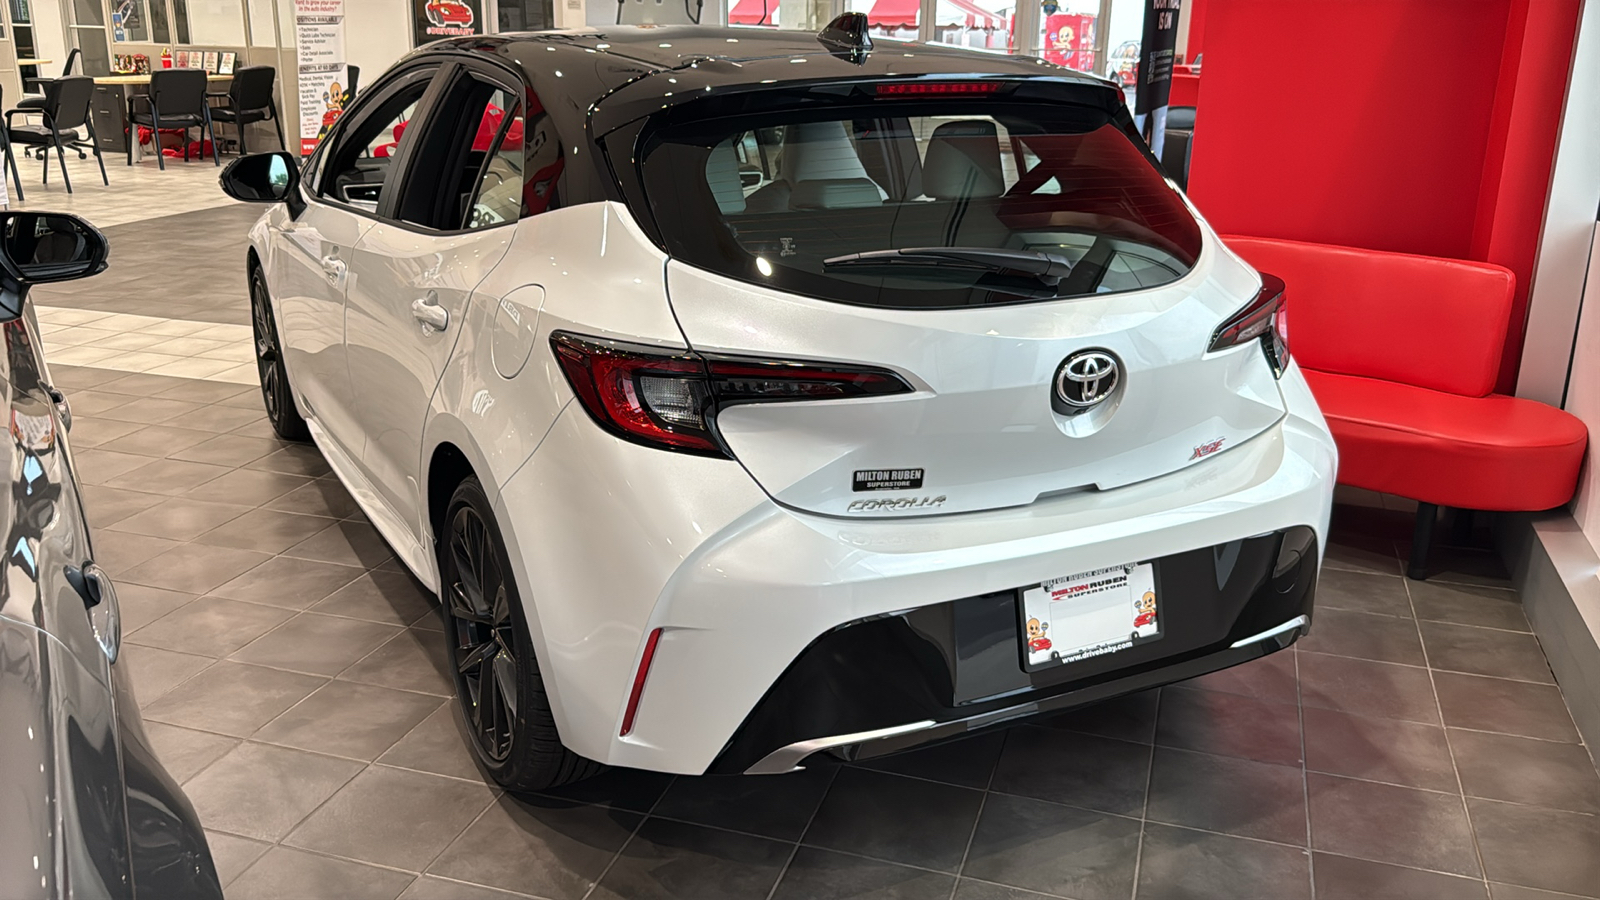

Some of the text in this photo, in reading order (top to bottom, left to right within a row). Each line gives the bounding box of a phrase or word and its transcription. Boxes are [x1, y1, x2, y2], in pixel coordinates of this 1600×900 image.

[856, 470, 922, 482] MILTON RUBEN
[847, 495, 947, 512] COROLLA
[1051, 576, 1128, 598] MILTON RUBEN
[1067, 582, 1128, 599] SUPERSTORE
[1062, 641, 1133, 664] www.drivebaby.com
